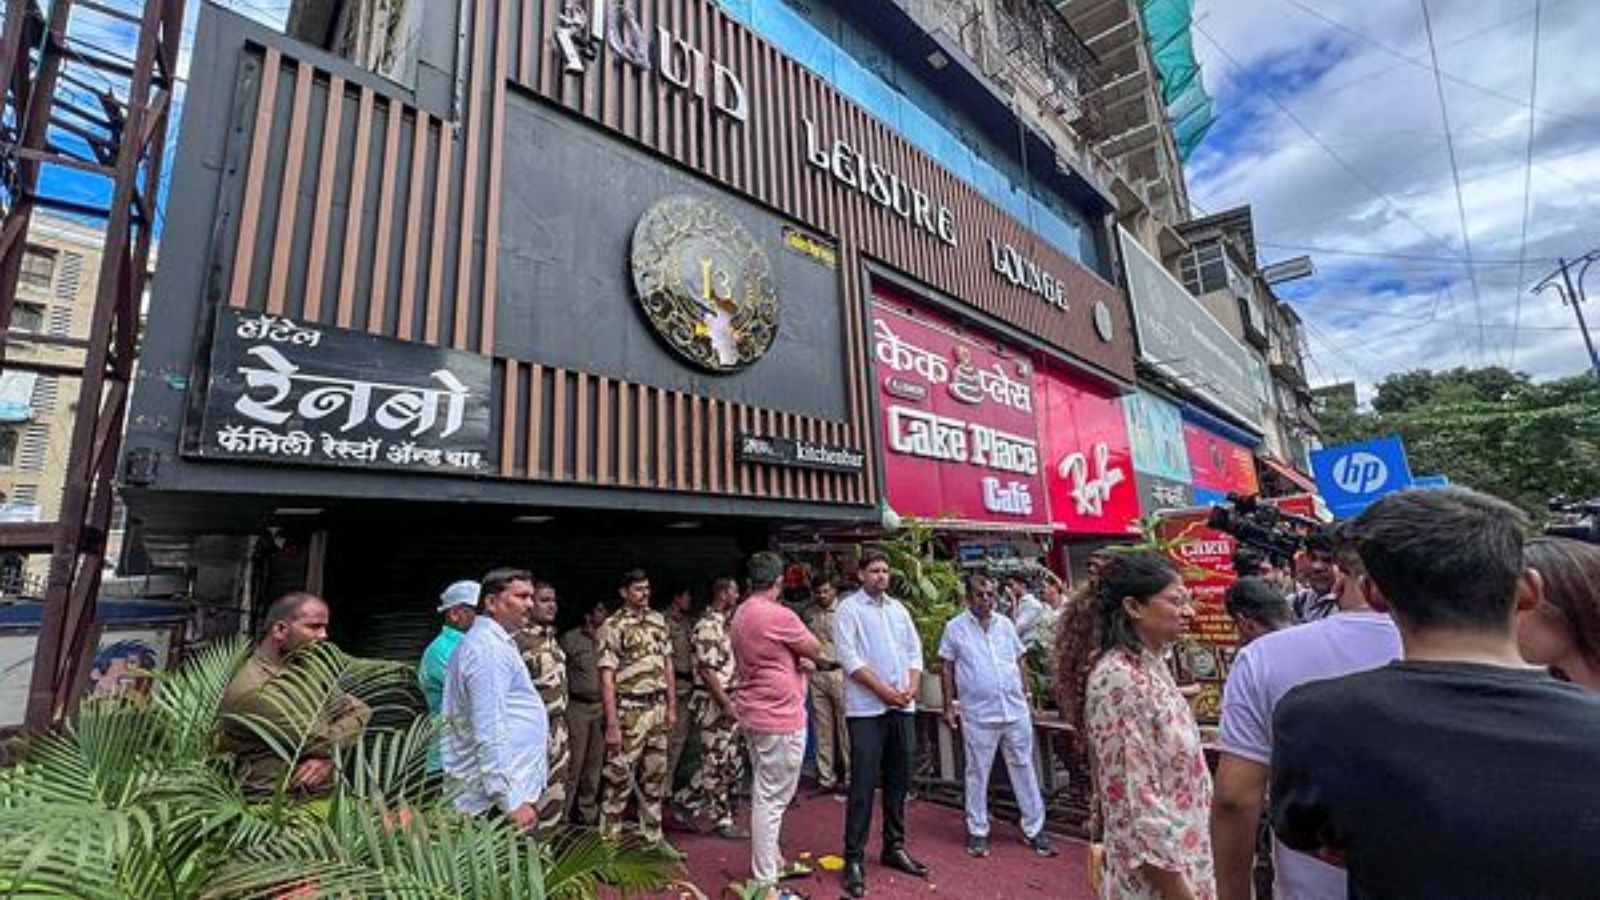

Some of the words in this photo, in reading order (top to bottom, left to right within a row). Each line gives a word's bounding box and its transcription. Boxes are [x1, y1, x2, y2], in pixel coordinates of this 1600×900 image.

[803, 117, 958, 248] LEISURE
[990, 236, 1070, 312] LOUNGE
[236, 313, 322, 347] हॉटेल
[874, 318, 949, 384] केक
[234, 344, 472, 438] रेनबो
[888, 404, 966, 462] Cake
[968, 423, 1038, 475] Place
[983, 476, 1033, 515] Café
[1341, 452, 1381, 494] hp
